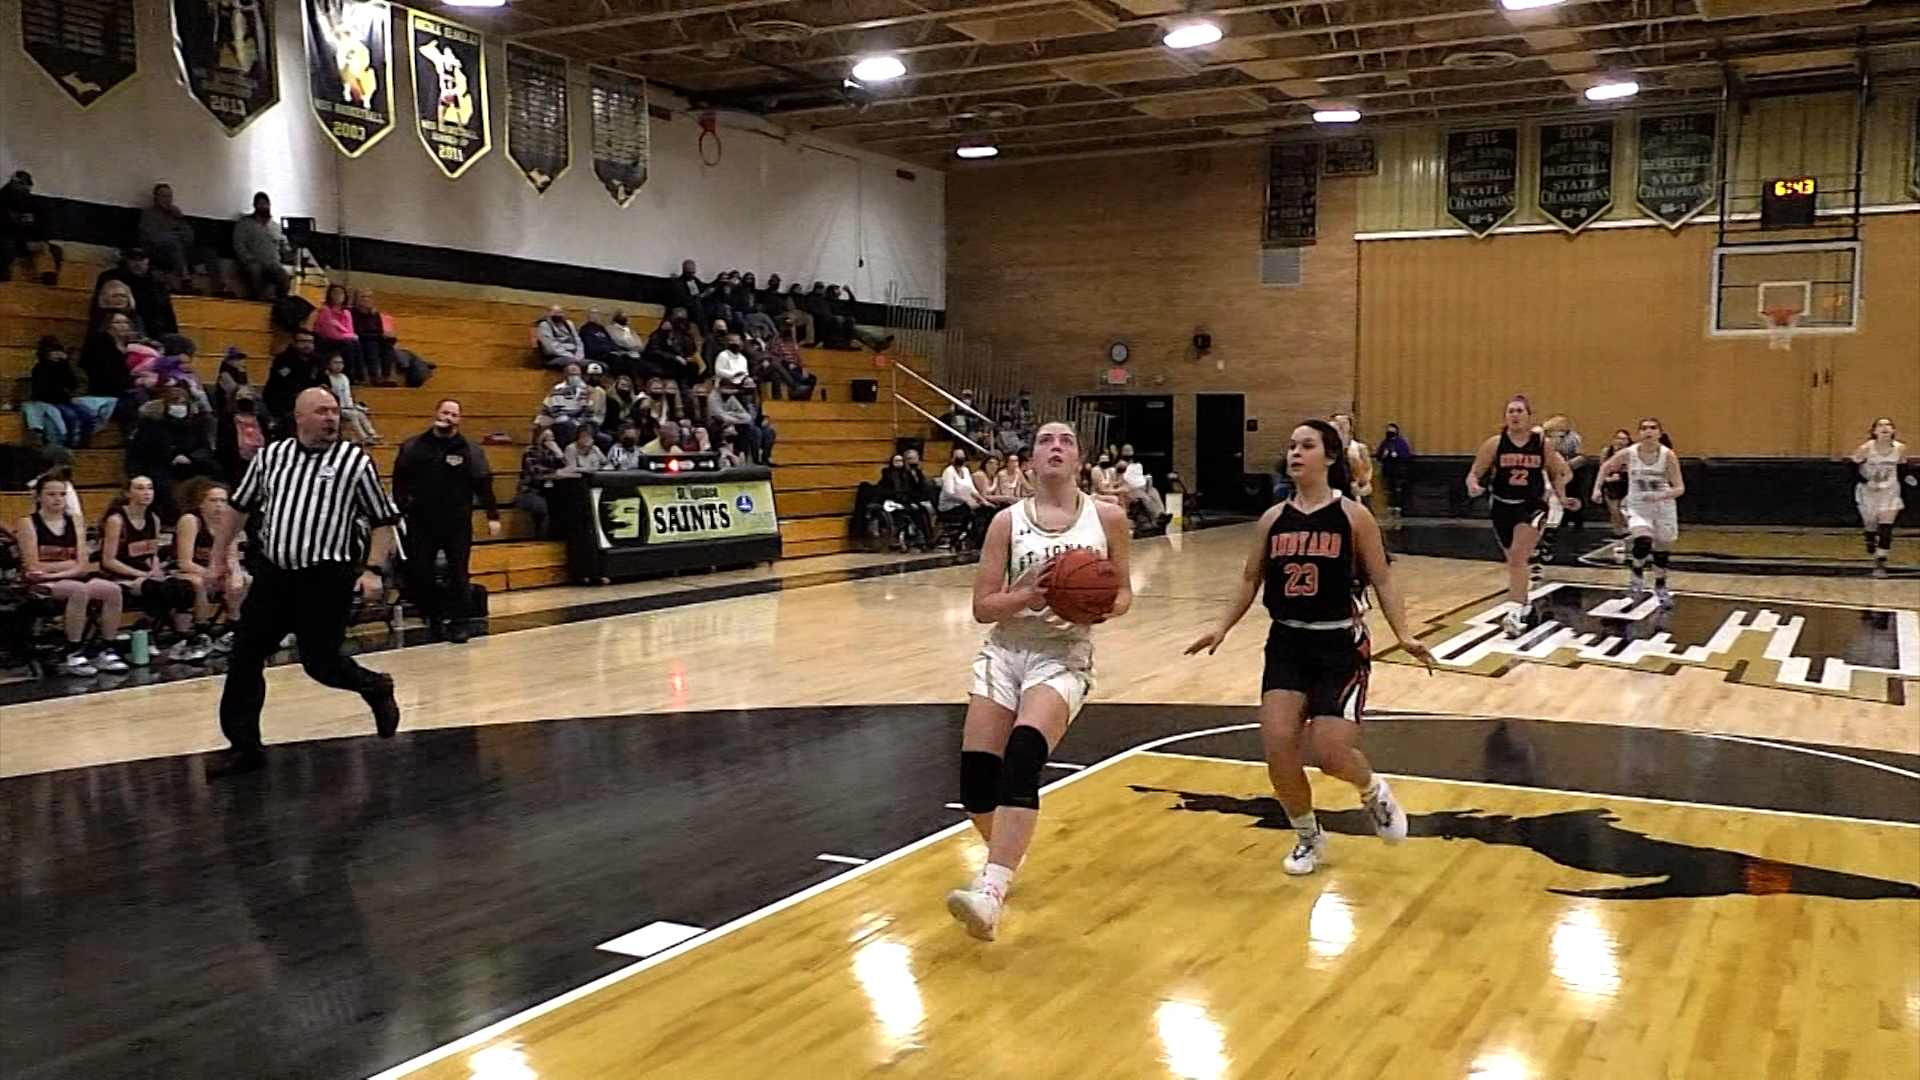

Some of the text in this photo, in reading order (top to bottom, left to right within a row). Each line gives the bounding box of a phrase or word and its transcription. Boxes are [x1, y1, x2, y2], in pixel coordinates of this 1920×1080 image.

[1459, 185, 1501, 196] STATE
[1540, 185, 1611, 204] CHAMPIONS
[1553, 179, 1596, 191] STATE
[1775, 179, 1815, 196] 6:43
[1449, 191, 1515, 210] CHAMPIONS
[1508, 468, 1530, 487] 22
[653, 503, 732, 535] SAINTS
[1283, 562, 1319, 597] 23
